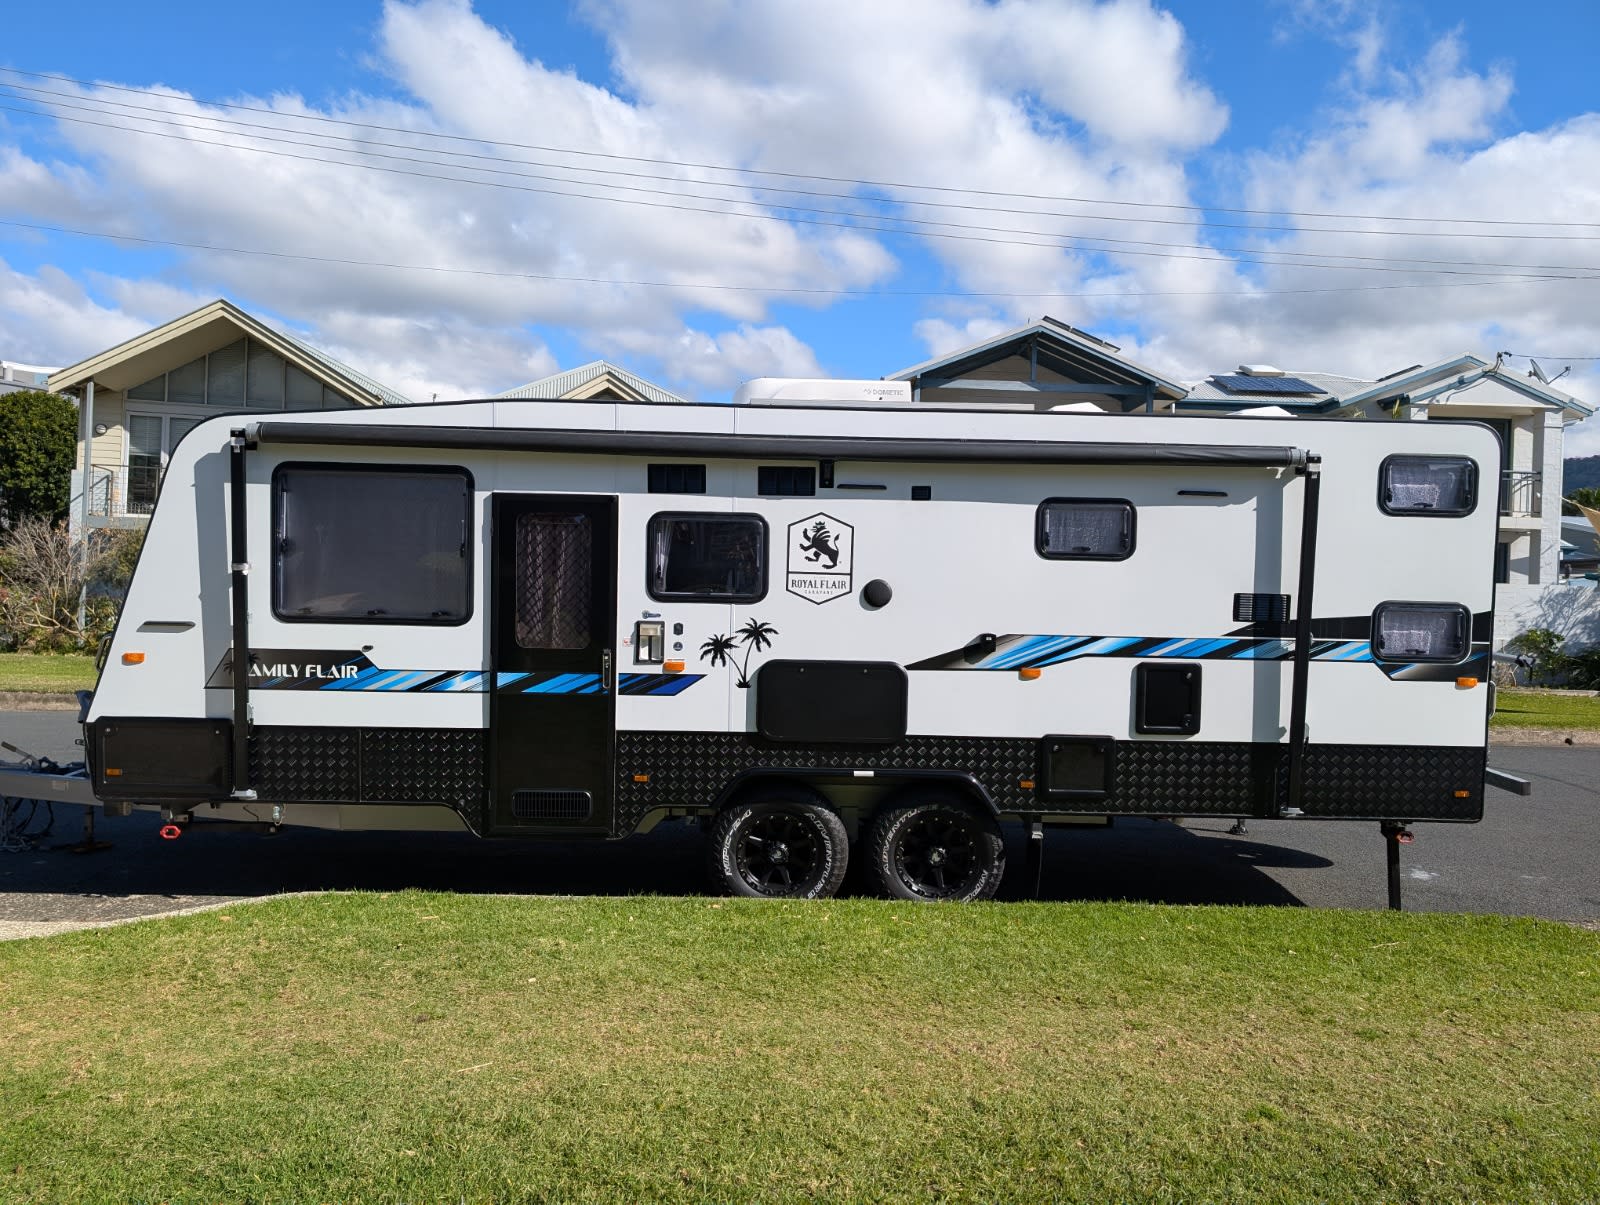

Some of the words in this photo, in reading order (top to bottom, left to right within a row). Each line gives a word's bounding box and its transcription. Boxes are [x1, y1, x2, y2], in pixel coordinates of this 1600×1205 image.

[791, 579, 819, 589] ROYAL
[820, 580, 847, 590] FLAIR
[248, 663, 301, 679] AMILY
[305, 664, 359, 679] FLAIR
